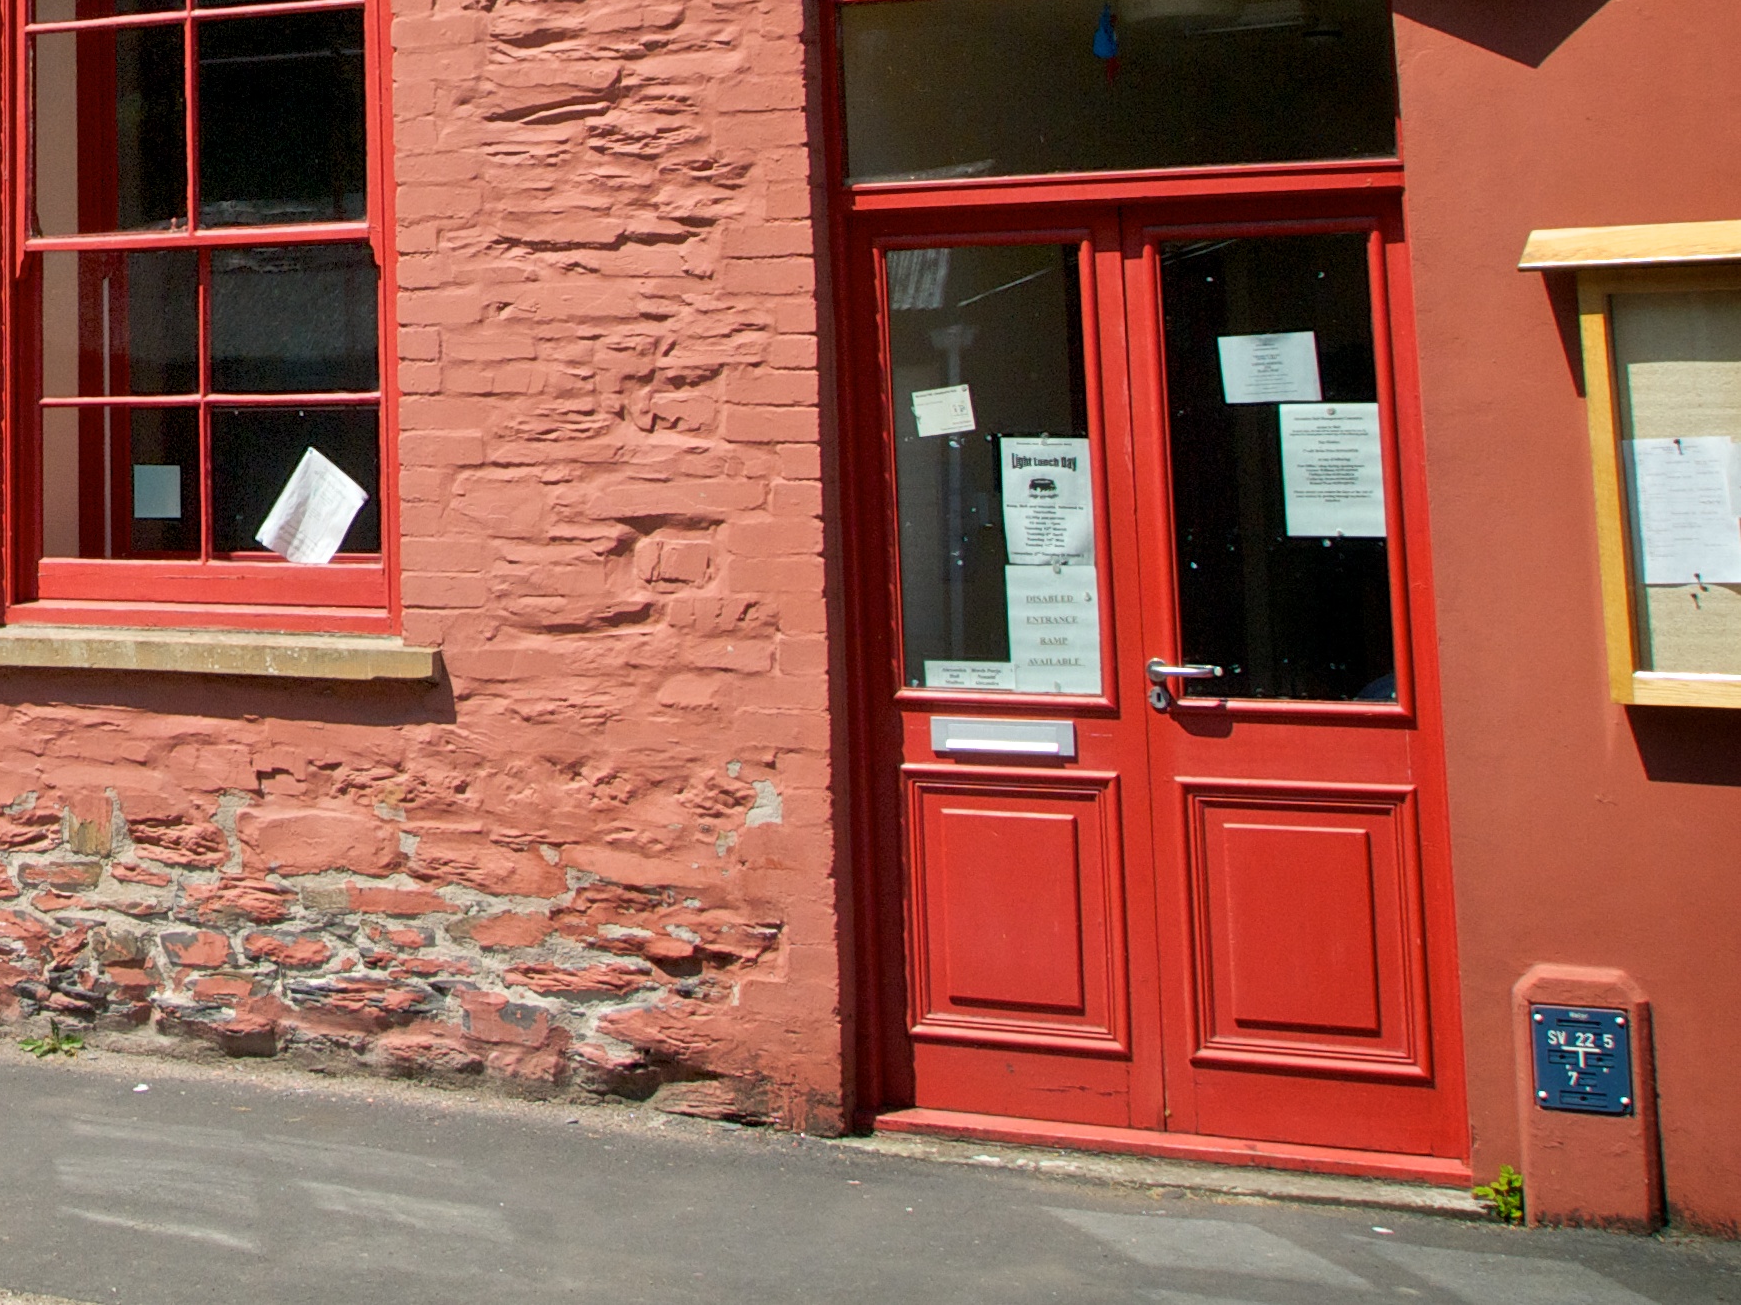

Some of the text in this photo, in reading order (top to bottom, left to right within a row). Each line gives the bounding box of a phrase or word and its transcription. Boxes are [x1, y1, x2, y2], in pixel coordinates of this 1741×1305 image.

[1025, 594, 1074, 604] DISABLED
[1026, 615, 1079, 625] ENTRANCE
[1039, 636, 1068, 646] RAMP
[1027, 657, 1081, 667] AVAILABLE
[1547, 1029, 1615, 1049] SV 22 5
[1567, 1070, 1579, 1087] 7
